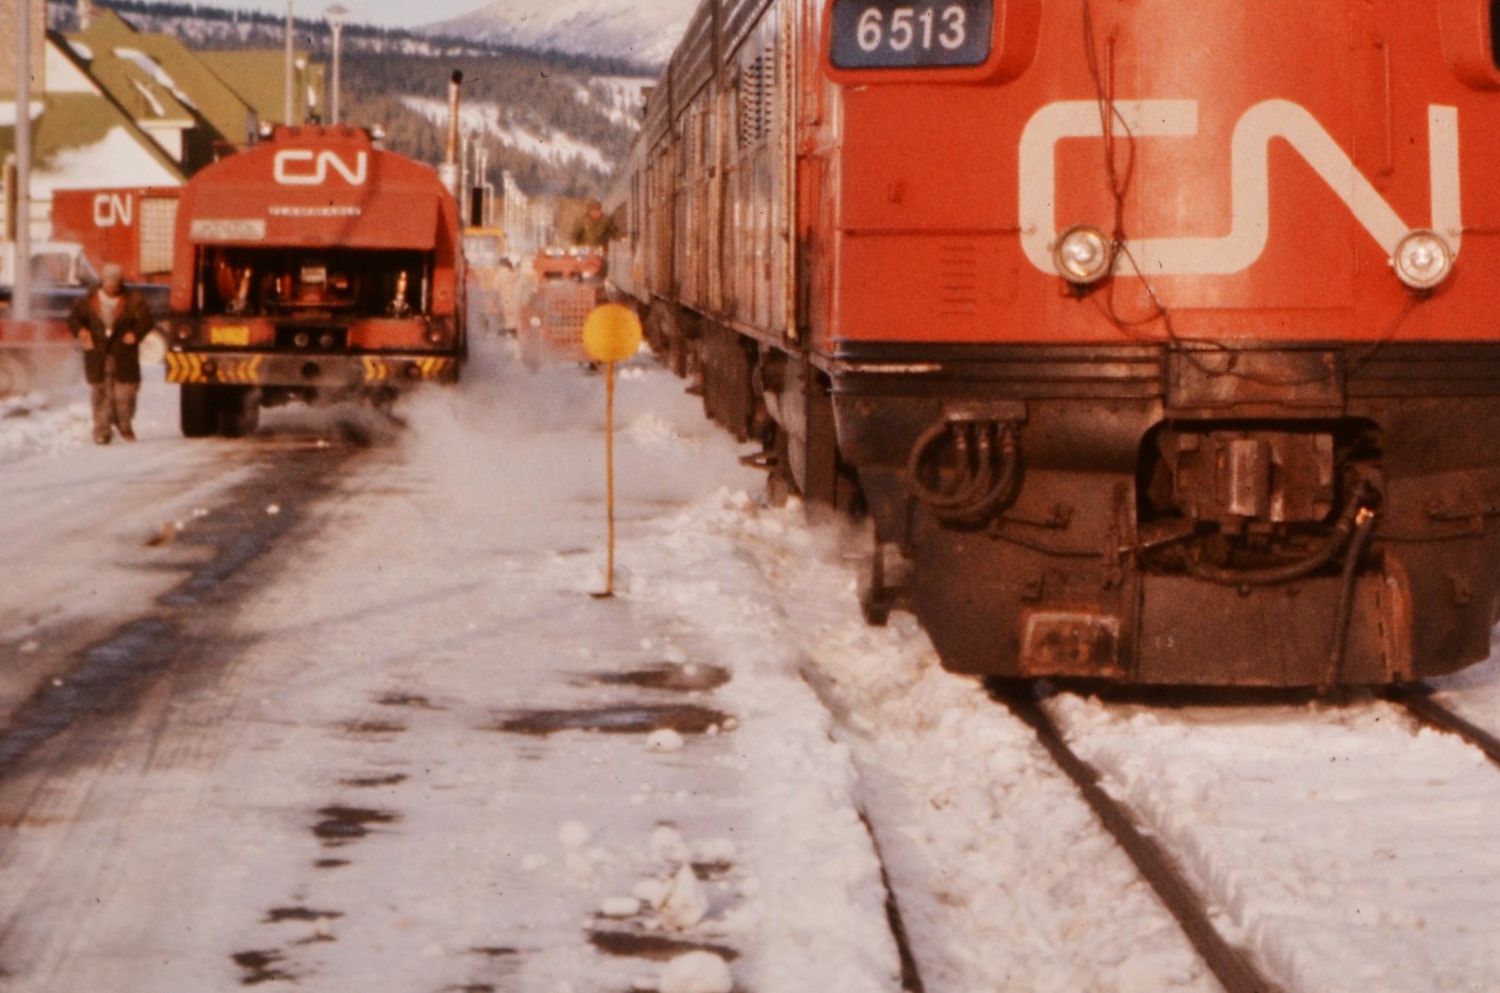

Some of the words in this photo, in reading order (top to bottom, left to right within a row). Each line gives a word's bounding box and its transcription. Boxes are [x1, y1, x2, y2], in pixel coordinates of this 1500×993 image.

[857, 4, 966, 52] 6513
[273, 149, 367, 186] CN
[93, 192, 133, 227] CN
[1018, 98, 1463, 283] CN
